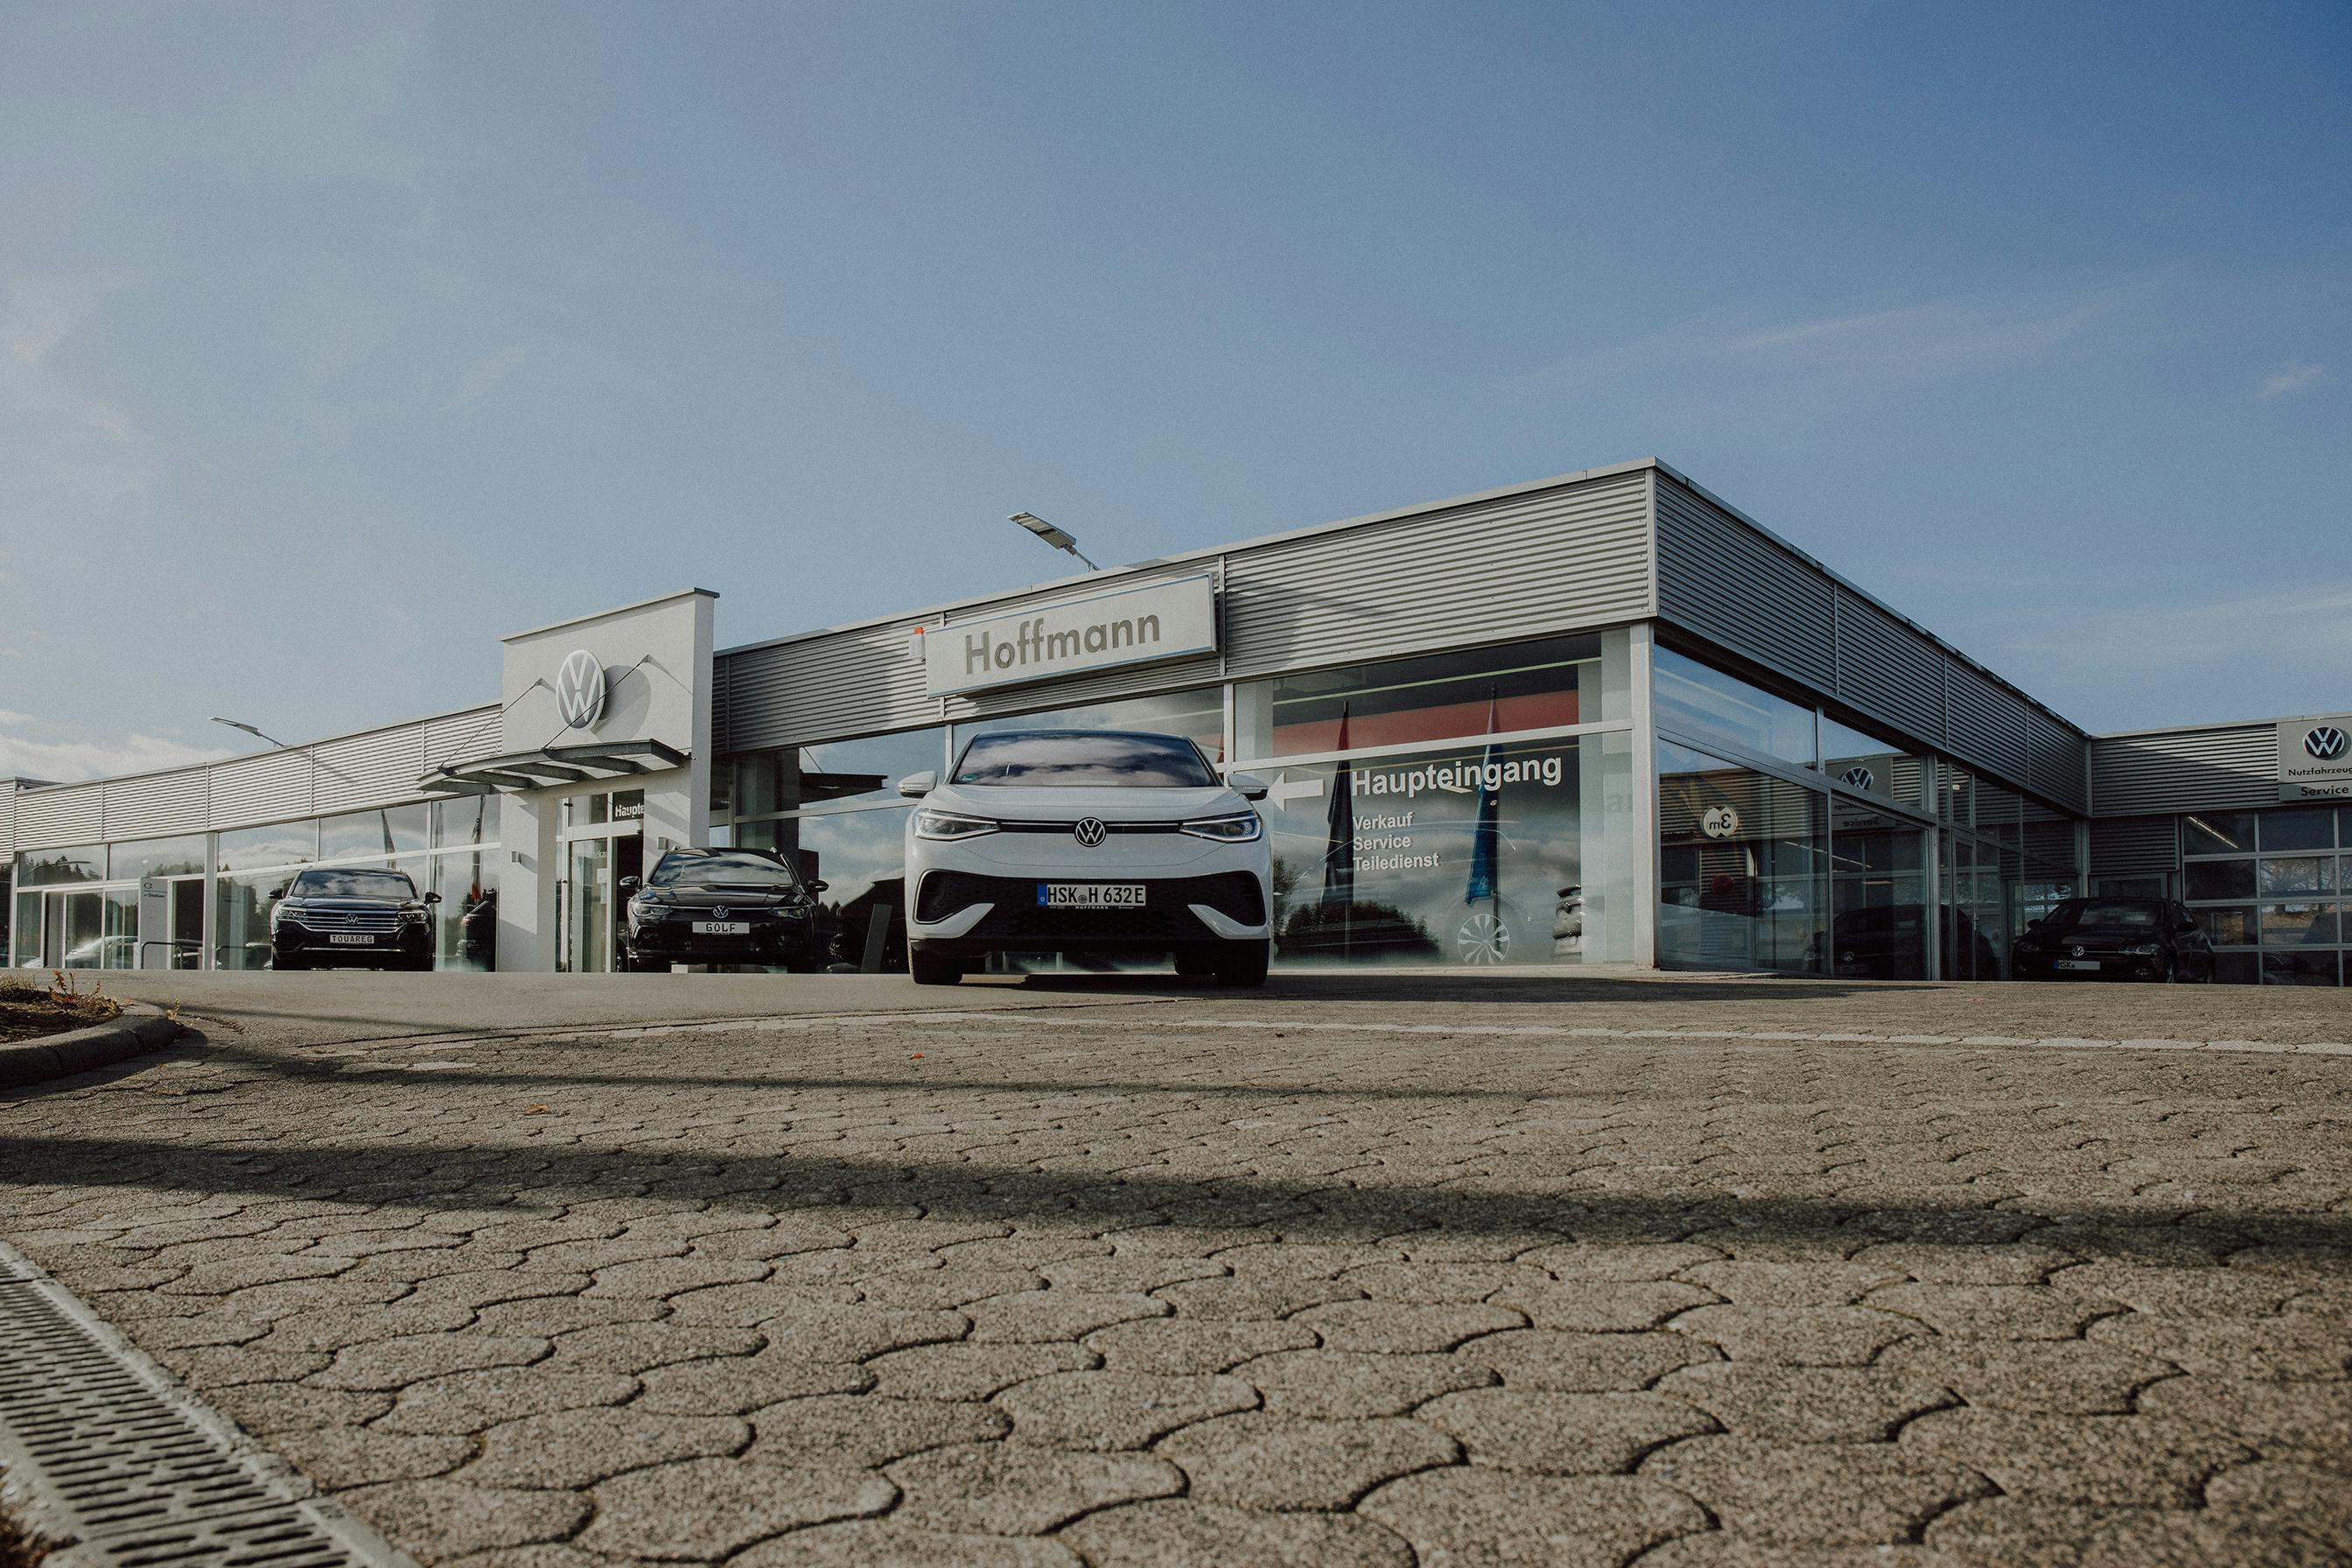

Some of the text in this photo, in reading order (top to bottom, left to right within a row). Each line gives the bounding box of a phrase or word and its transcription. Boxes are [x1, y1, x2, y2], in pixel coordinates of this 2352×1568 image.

[965, 614, 1160, 675] Hoffmann
[1351, 757, 1562, 797] Haupteingang
[2300, 786, 2349, 796] Service
[1353, 812, 1414, 830] Verkauf
[1353, 836, 1412, 851] Service
[1353, 852, 1440, 872] Teiledienst
[1047, 886, 1144, 903] HSK H 632E
[705, 922, 736, 932] GOLF
[332, 934, 374, 943] TOUAREG
